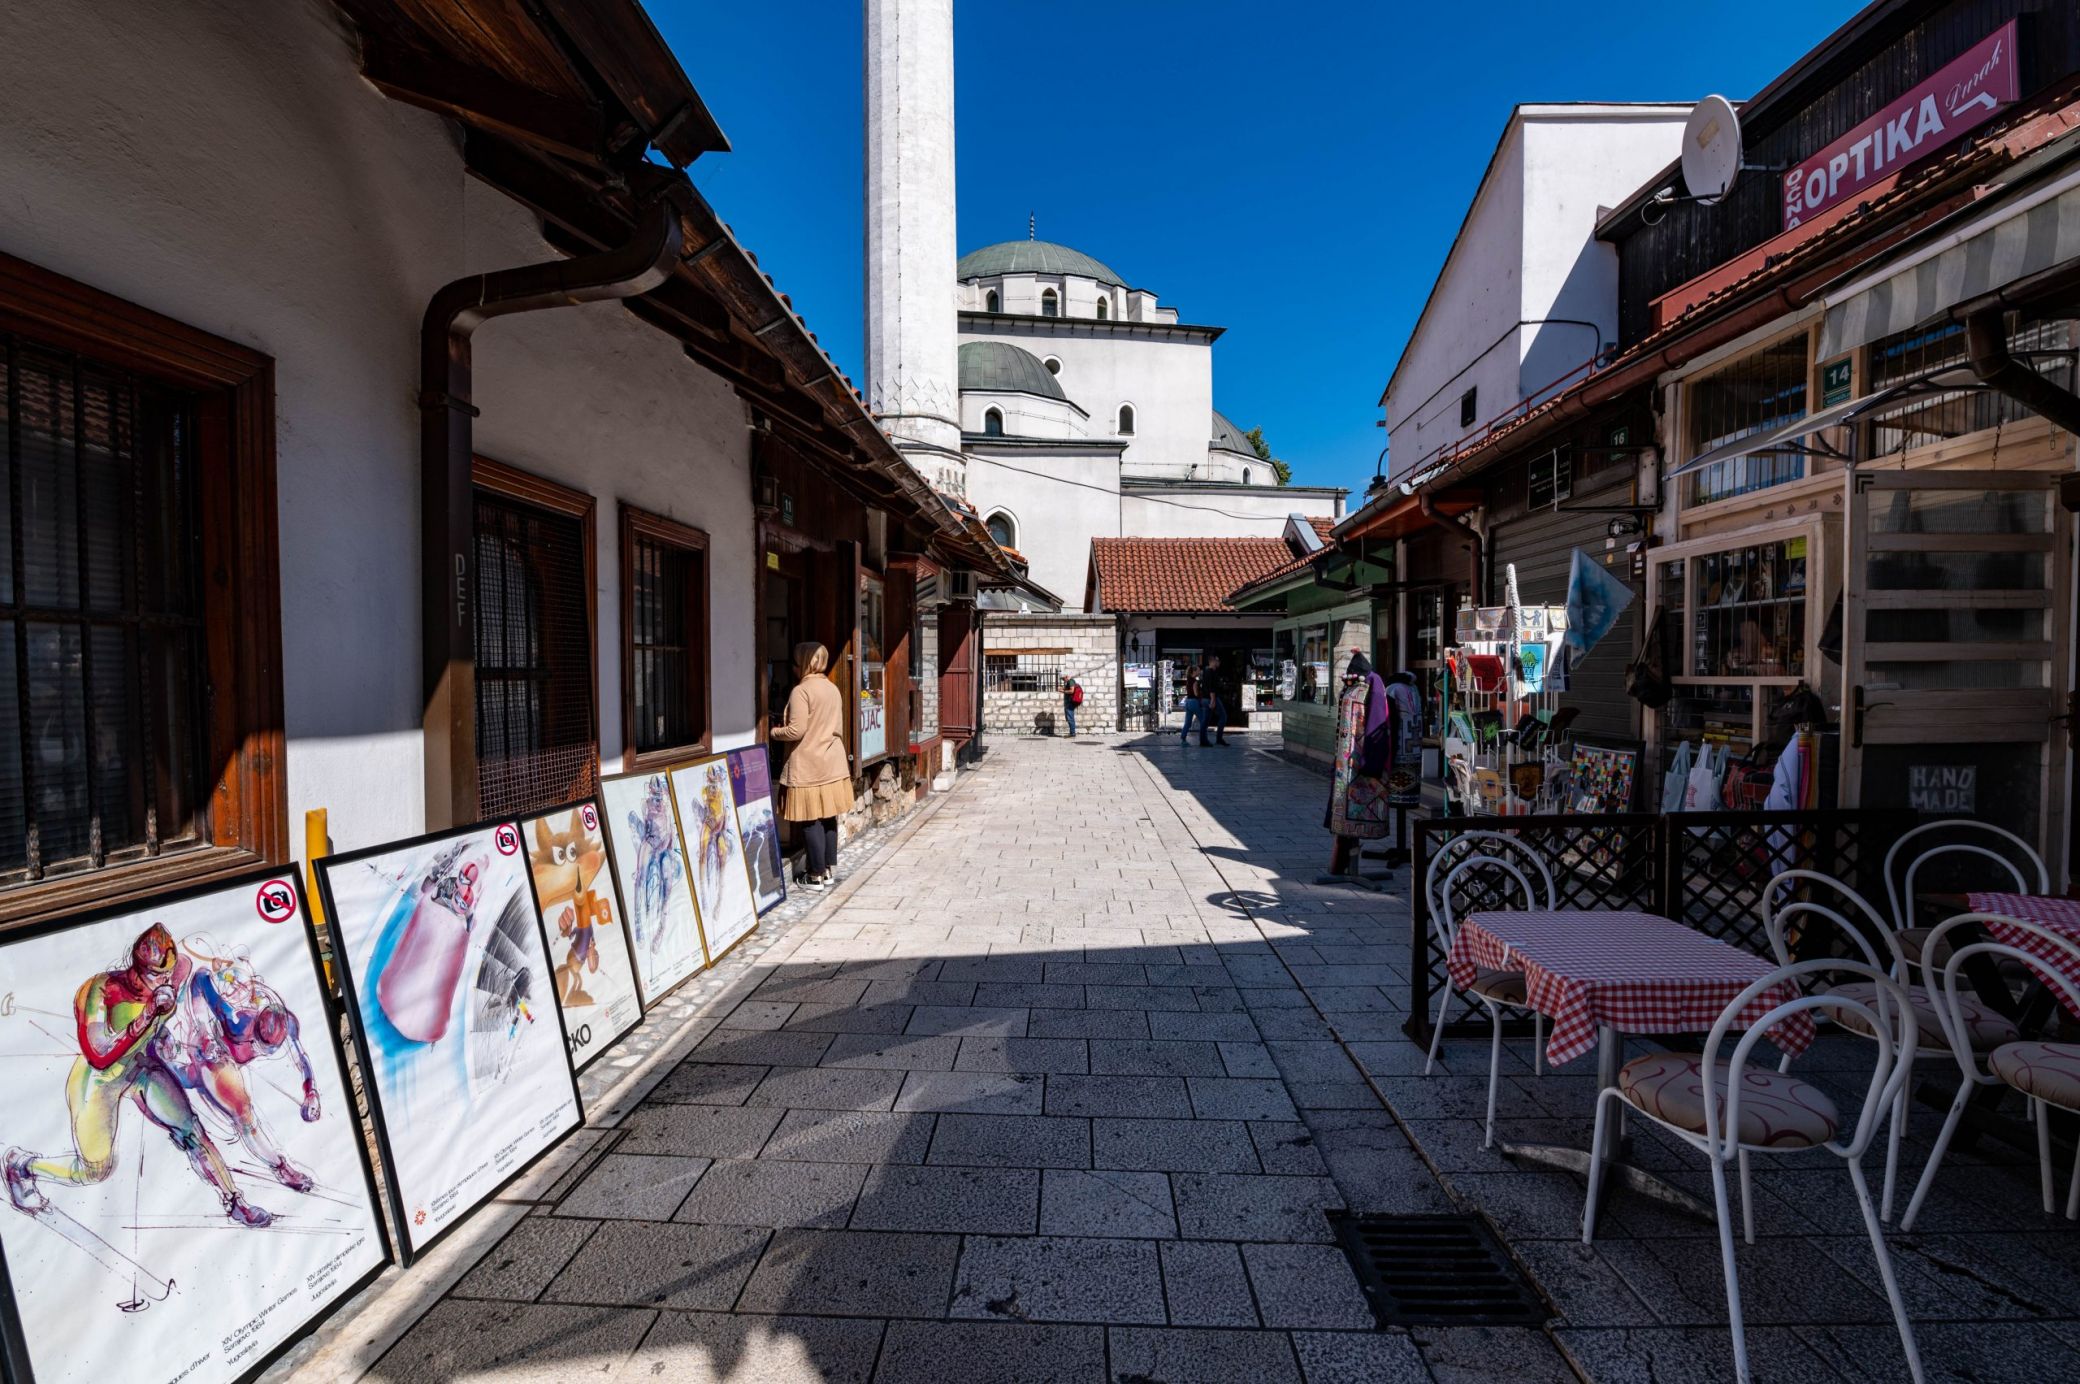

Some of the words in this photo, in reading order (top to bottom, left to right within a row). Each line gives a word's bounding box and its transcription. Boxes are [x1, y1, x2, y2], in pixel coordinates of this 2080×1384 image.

[1804, 92, 1945, 209] OPTIKA
[1830, 365, 1850, 385] 14
[1614, 432, 1625, 446] 16
[784, 499, 792, 513] 11
[1912, 767, 1975, 789] HAND
[1911, 789, 1972, 810] MADE
[567, 1023, 592, 1055] KO
[233, 1316, 260, 1338] Olympic
[258, 1302, 277, 1319] Winter
[223, 1331, 251, 1353] Sarajevo
[226, 1339, 259, 1366] Yugoslavia
